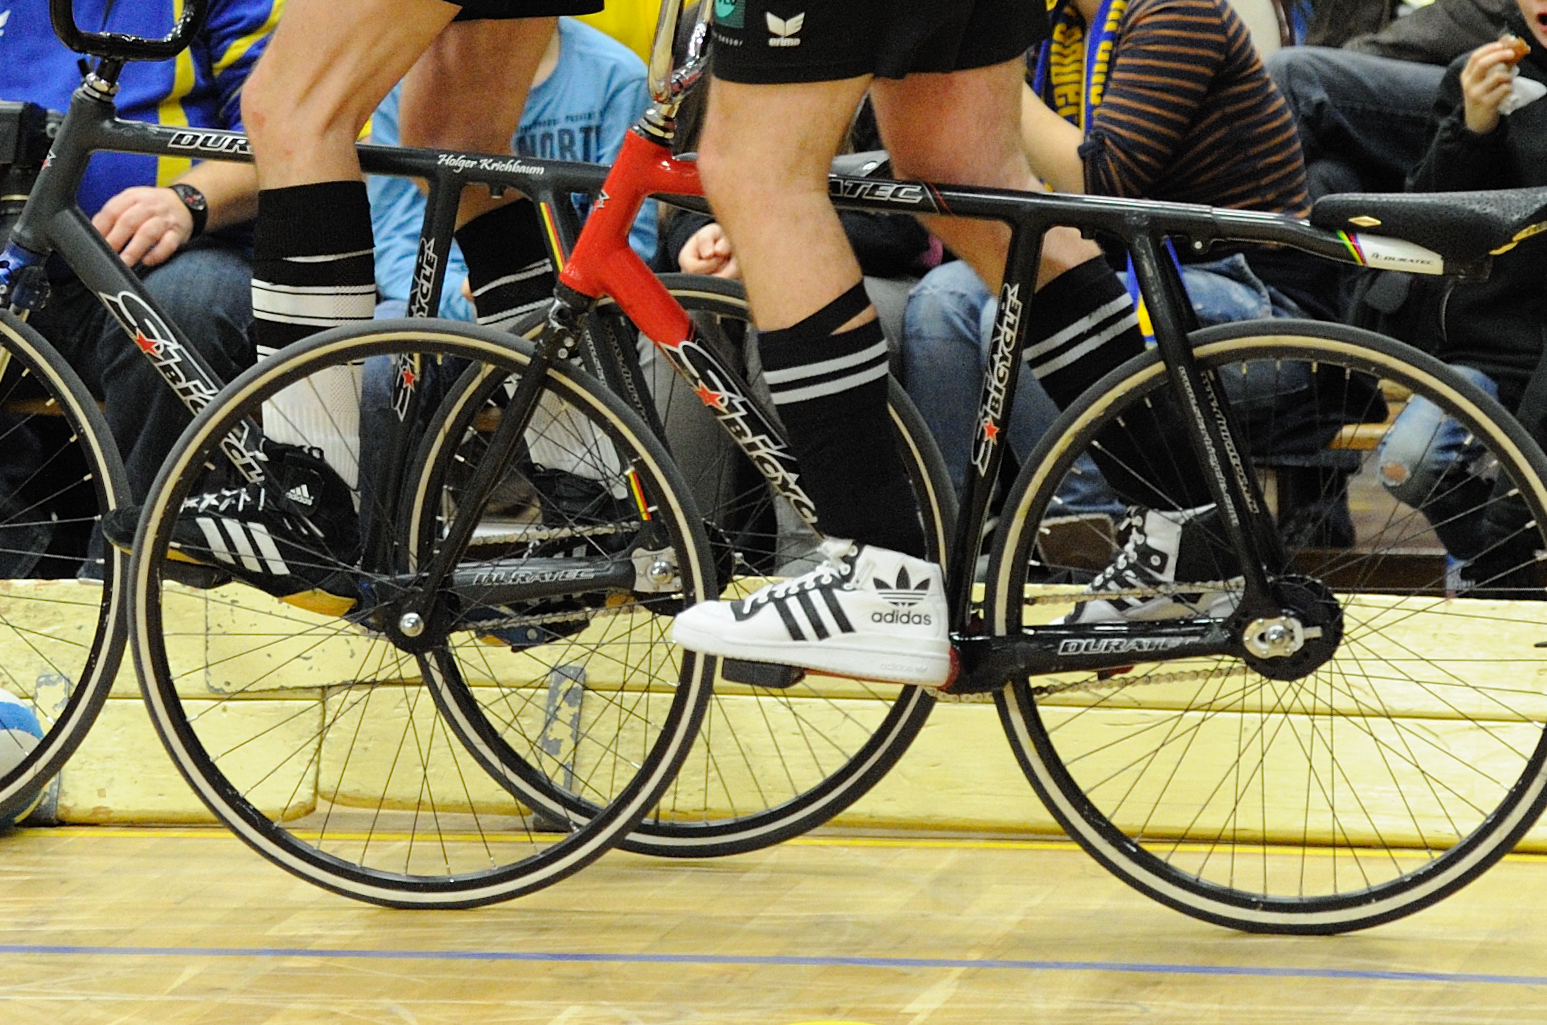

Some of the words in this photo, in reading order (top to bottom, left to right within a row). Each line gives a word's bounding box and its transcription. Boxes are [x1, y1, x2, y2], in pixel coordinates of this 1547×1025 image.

[437, 154, 478, 173] Holger
[479, 158, 545, 175] Krichbaum
[871, 609, 933, 627] adidas
